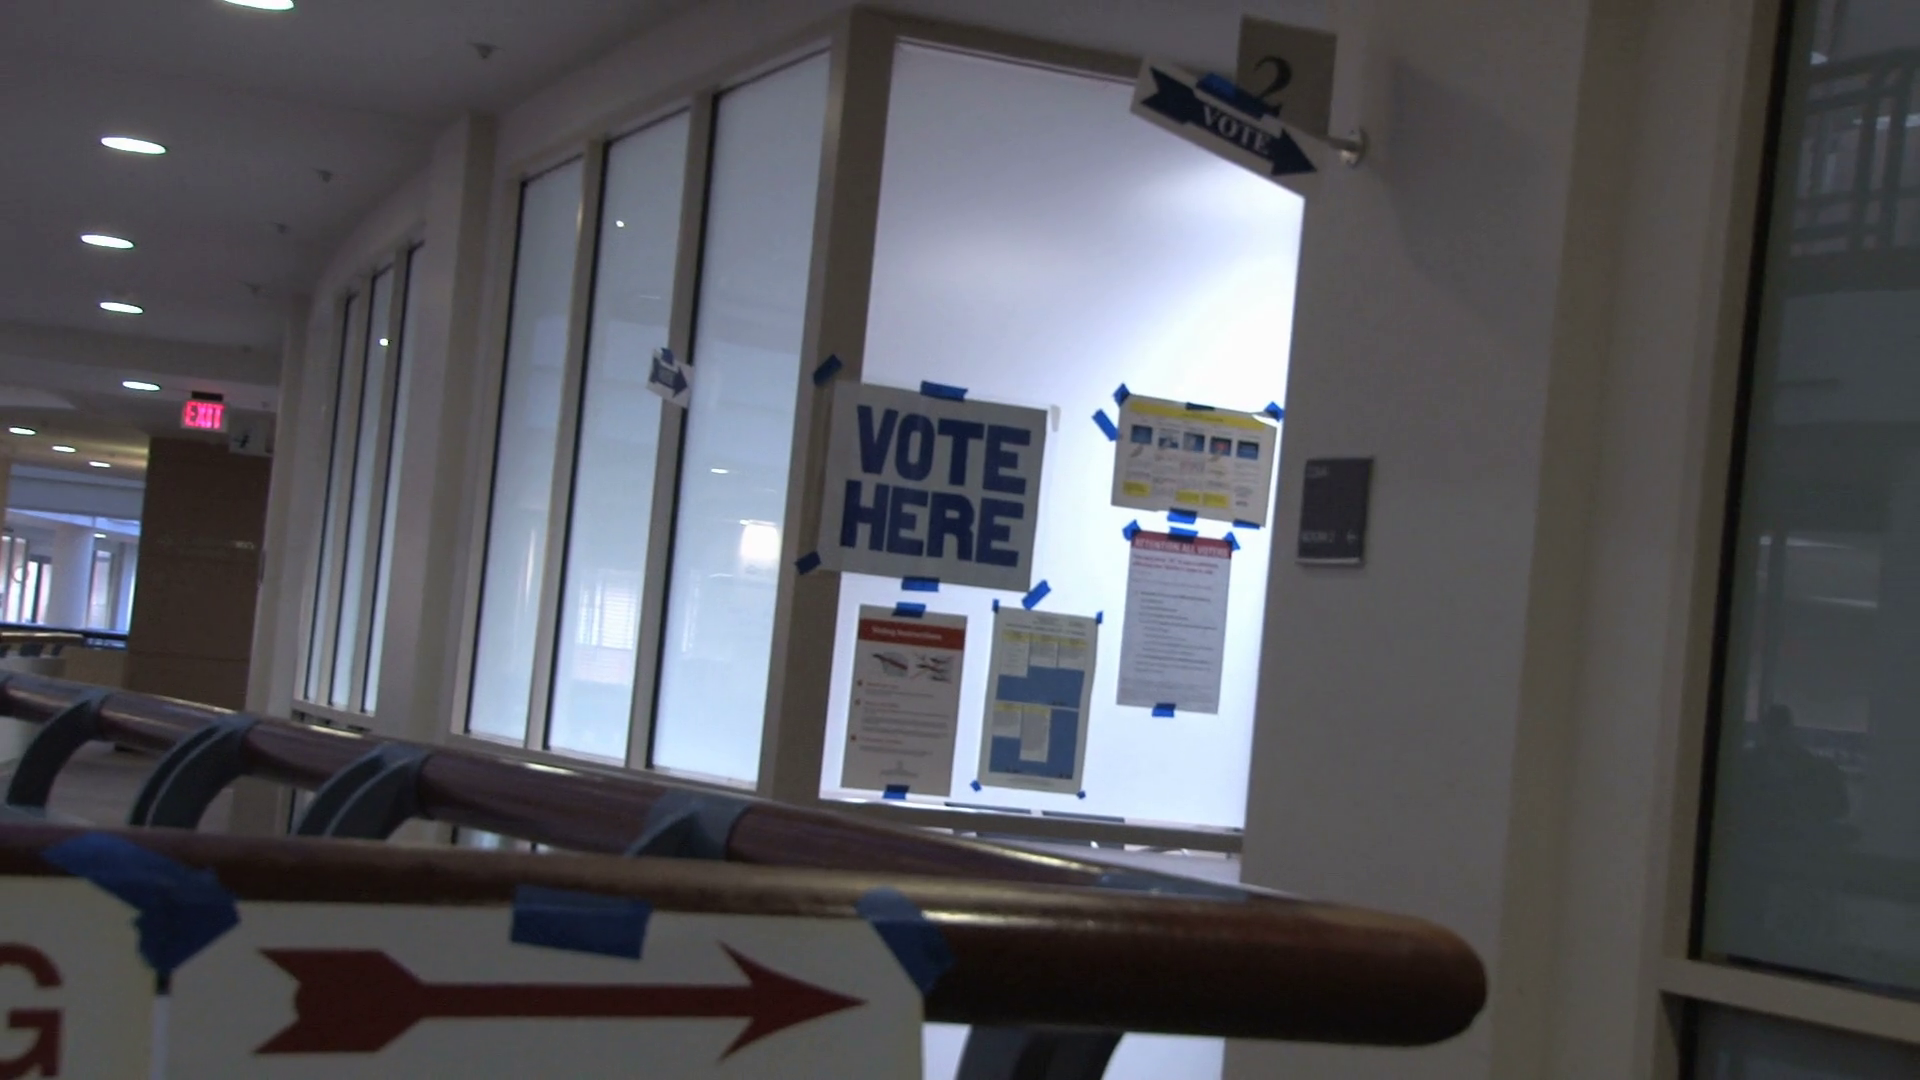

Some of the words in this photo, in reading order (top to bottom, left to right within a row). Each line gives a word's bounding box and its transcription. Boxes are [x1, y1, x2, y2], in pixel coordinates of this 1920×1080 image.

[1252, 56, 1294, 117] 2
[1203, 104, 1274, 155] VOTE
[184, 401, 226, 430] EXIT
[857, 404, 1031, 495] VOTE
[840, 479, 1024, 567] HERE
